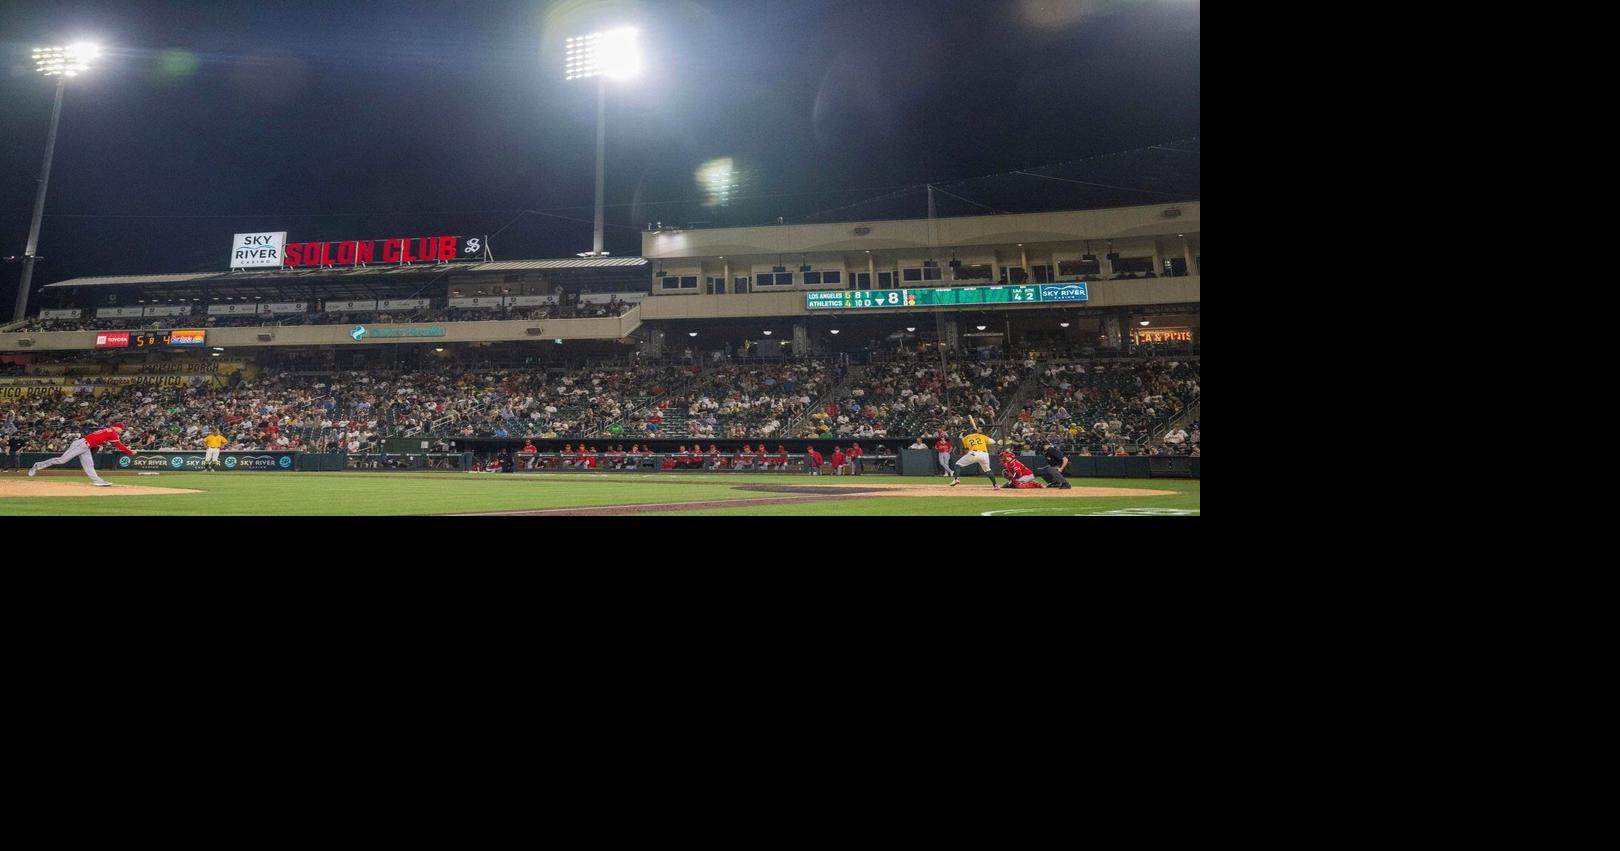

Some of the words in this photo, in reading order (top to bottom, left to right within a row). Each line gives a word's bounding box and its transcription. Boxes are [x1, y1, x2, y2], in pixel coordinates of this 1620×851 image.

[244, 235, 272, 246] SKY
[235, 249, 277, 259] RIVER
[284, 240, 374, 266] SOLON
[382, 236, 457, 263] CLUB
[888, 292, 899, 304] 8
[1026, 292, 1034, 300] 2
[136, 336, 144, 347] 5
[163, 336, 171, 344] 4
[137, 376, 182, 386] PACIFICO
[969, 438, 983, 446] 22
